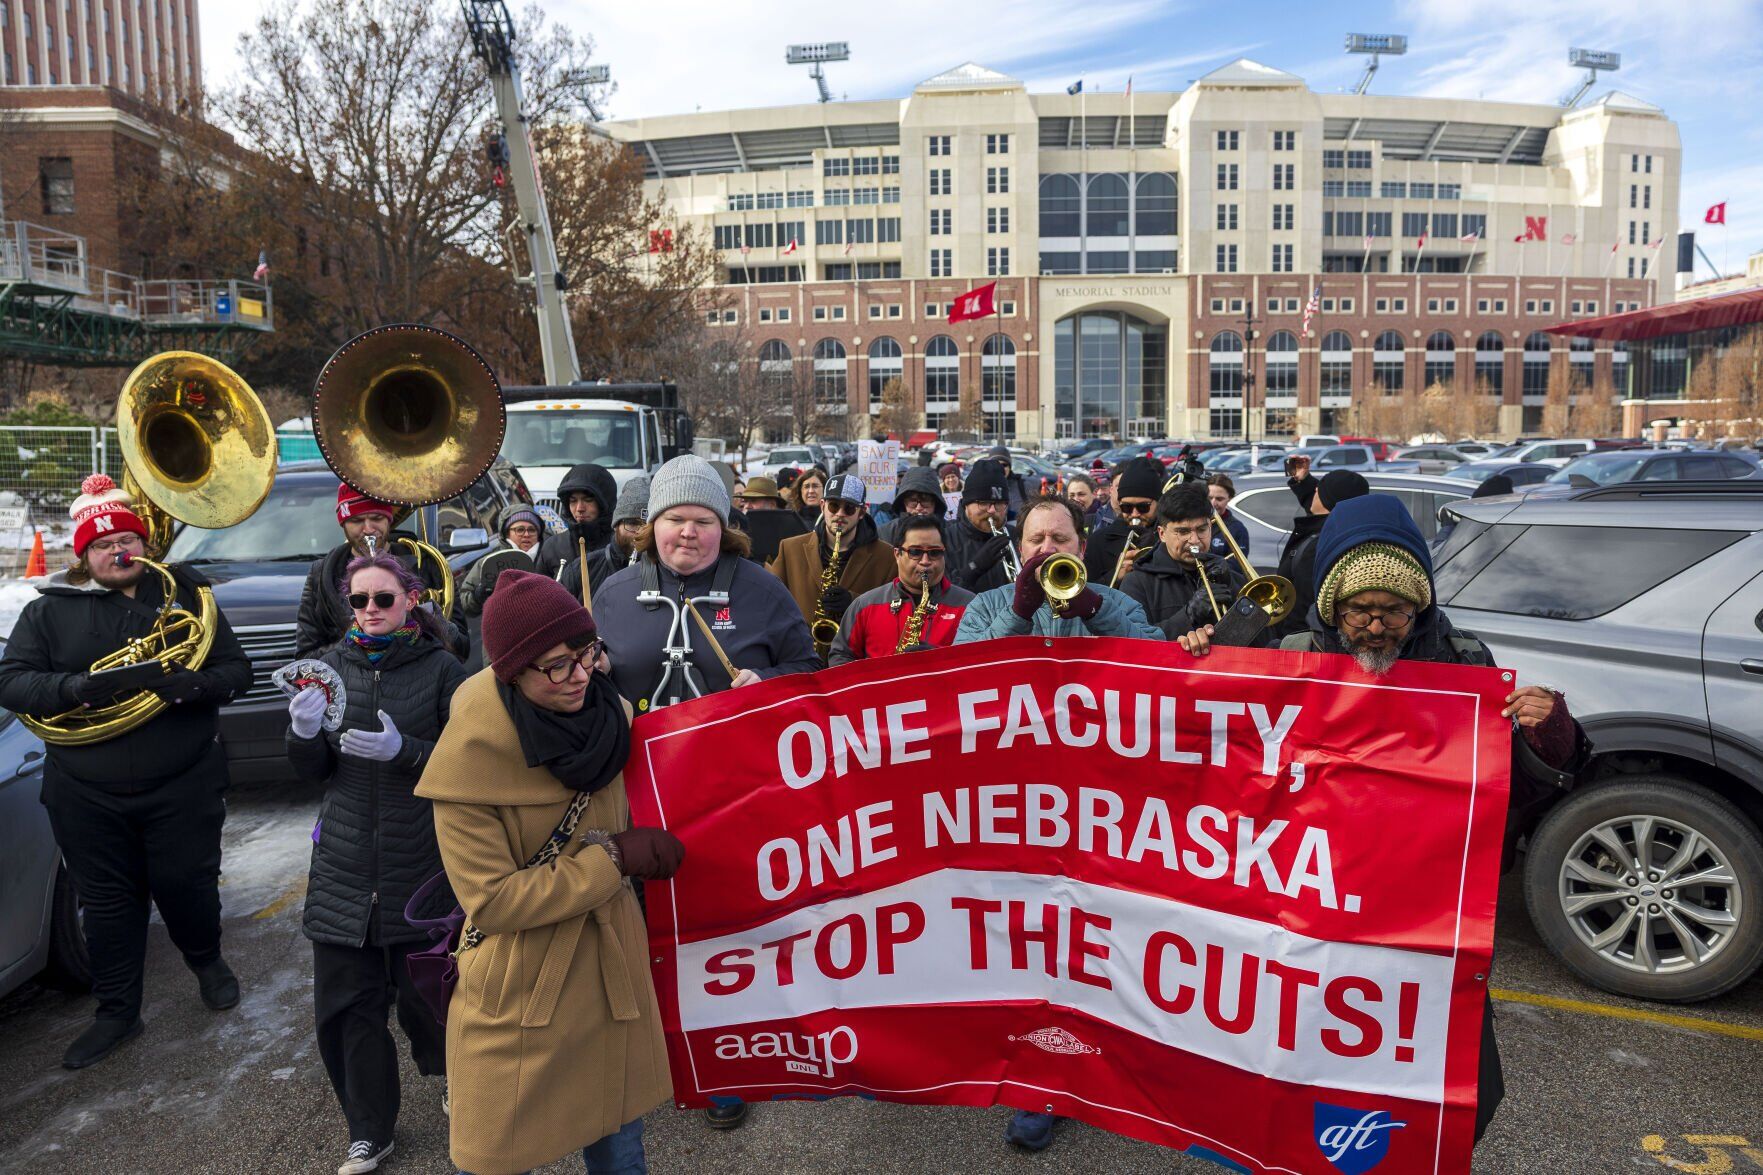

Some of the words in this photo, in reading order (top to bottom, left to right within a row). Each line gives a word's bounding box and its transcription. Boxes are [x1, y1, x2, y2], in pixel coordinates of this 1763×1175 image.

[1525, 216, 1547, 242] N
[1056, 287, 1116, 297] MEMORIAL
[1121, 286, 1171, 297] STADIUM
[861, 445, 896, 460] SAVE
[869, 461, 891, 474] OUR
[991, 486, 1003, 499] N
[341, 502, 351, 518] N
[94, 514, 115, 534] N
[716, 607, 730, 621] N
[777, 699, 931, 790] ONE
[957, 683, 1307, 793] FACULTY,
[756, 800, 898, 901] ONE
[922, 783, 1362, 914] NEBRASKA.
[703, 901, 926, 997] STOP
[951, 897, 1112, 991] THE
[1143, 931, 1420, 1063] CUTS!
[714, 1025, 859, 1079] aaup
[1065, 1040, 1091, 1052] LABEL
[1095, 1047, 1102, 1055] 3
[790, 1062, 816, 1074] UNL
[1319, 1110, 1407, 1162] aft
